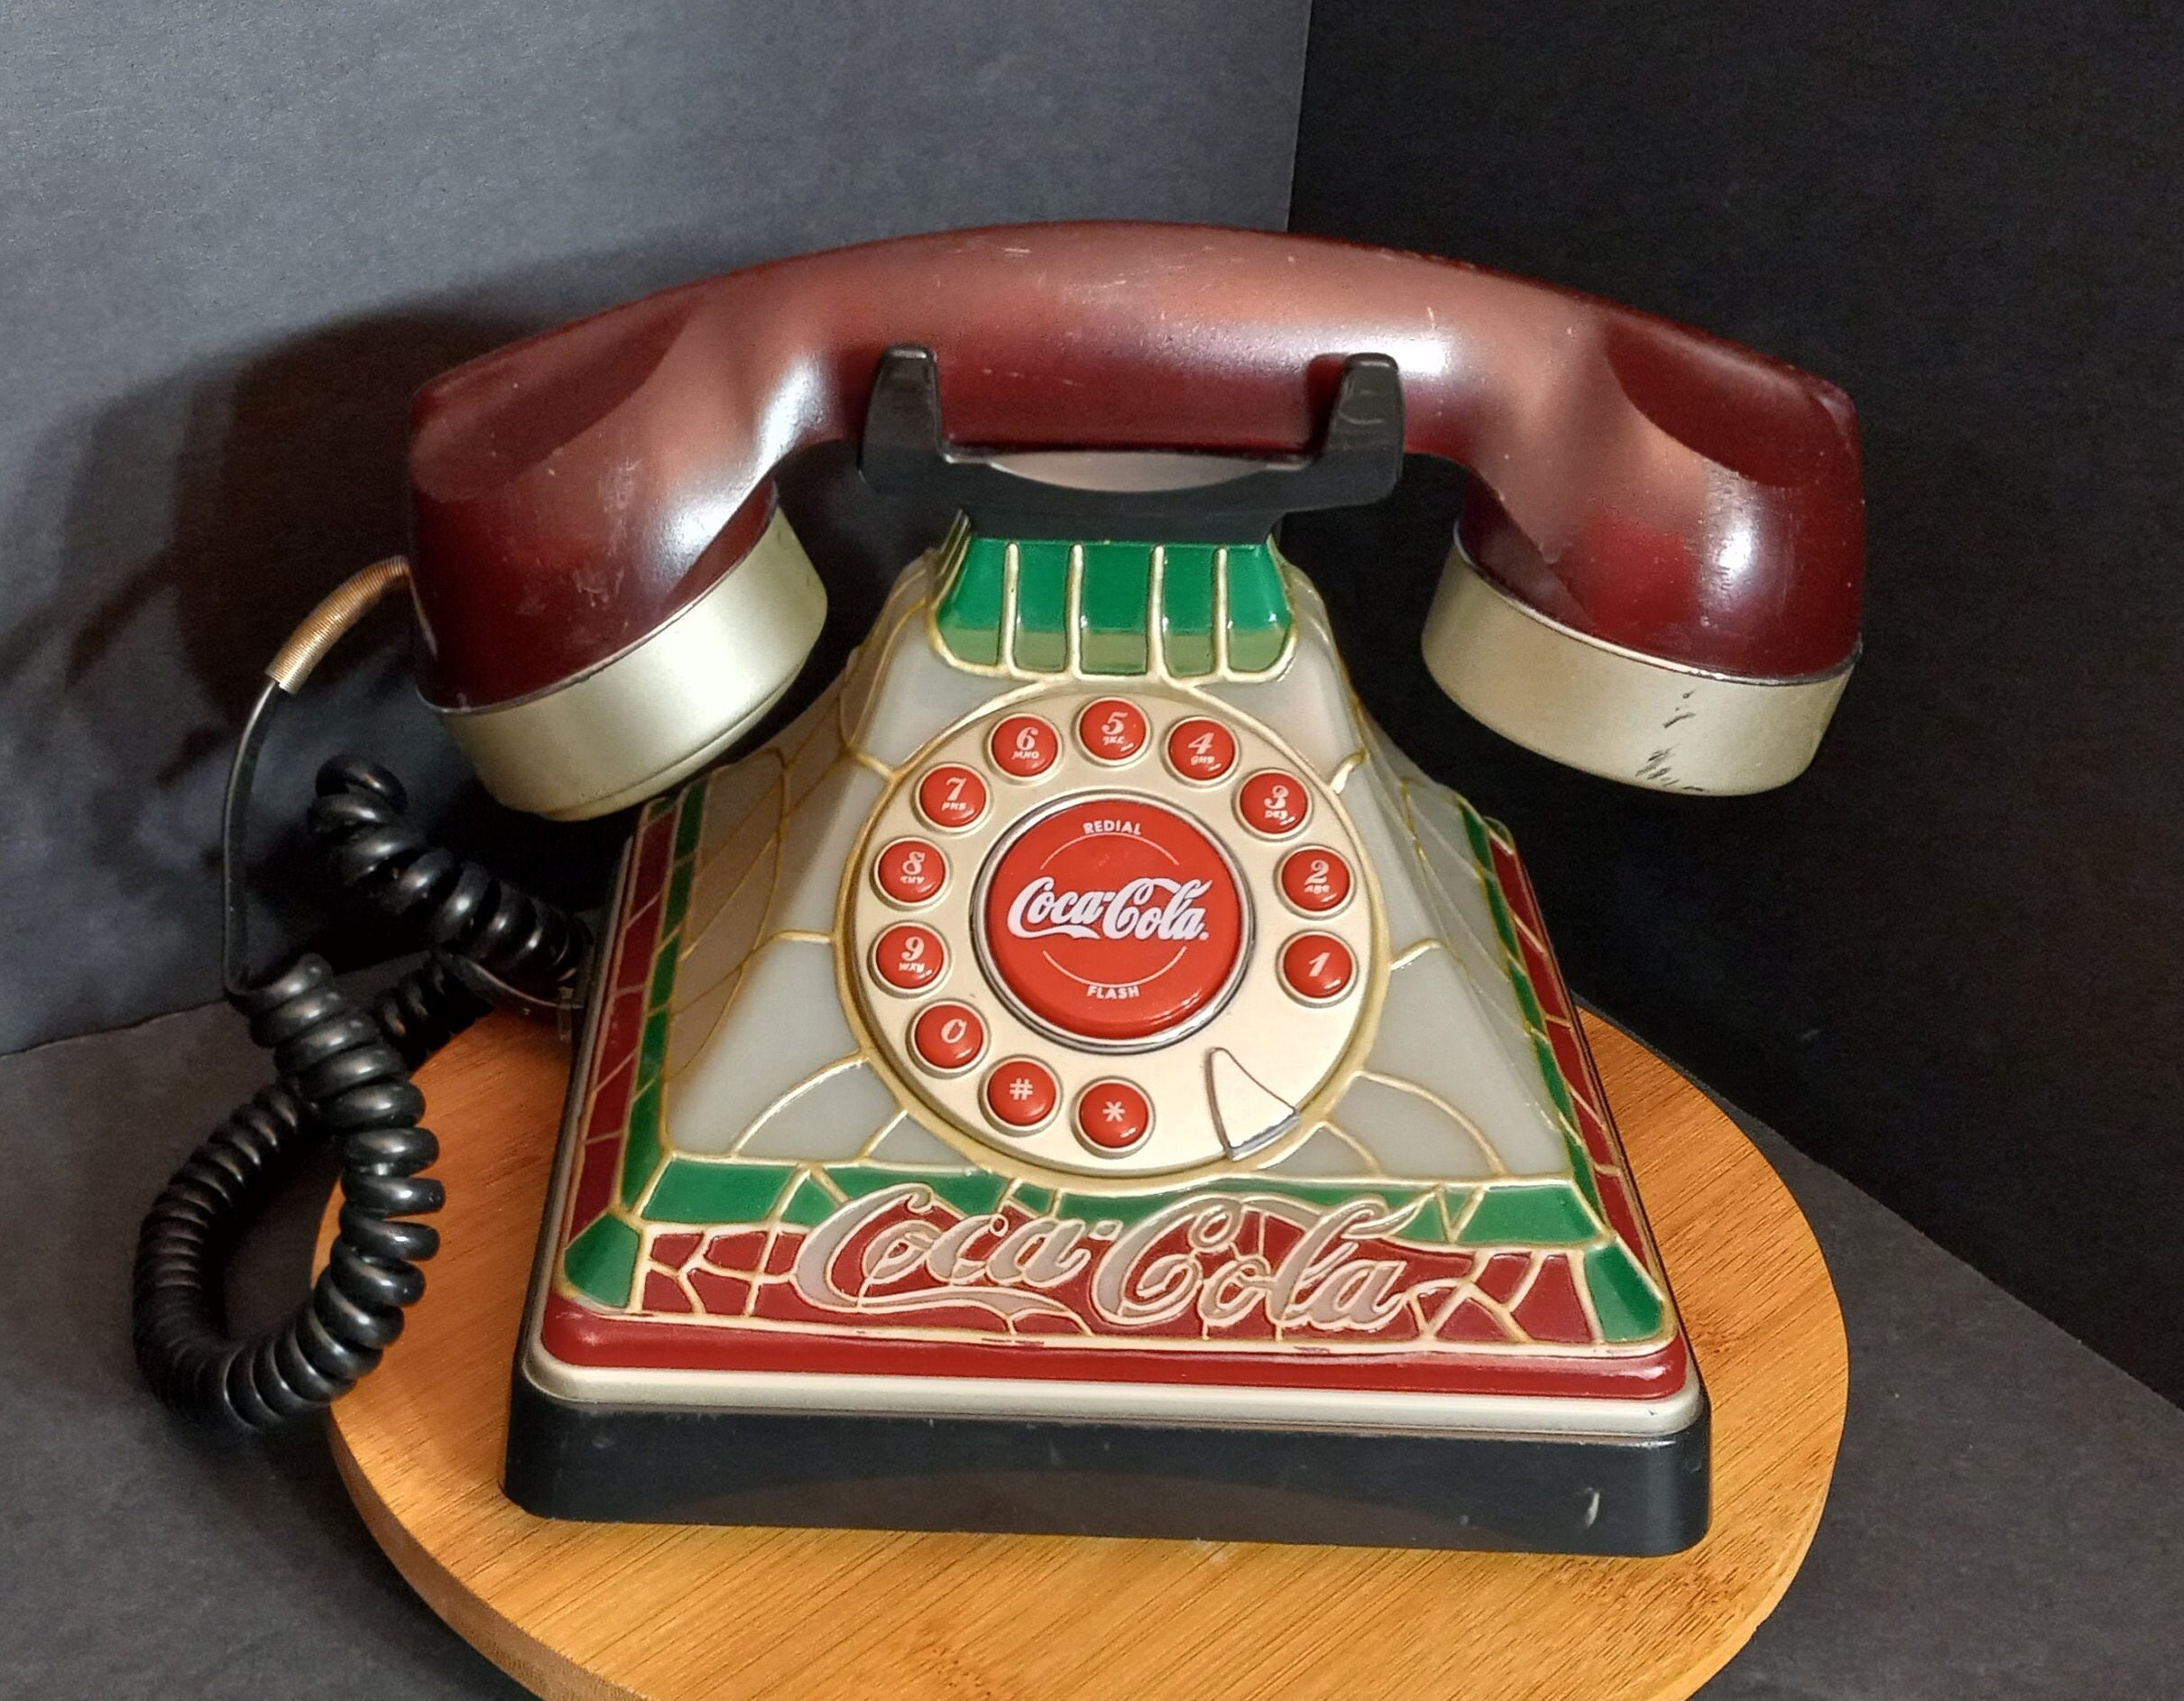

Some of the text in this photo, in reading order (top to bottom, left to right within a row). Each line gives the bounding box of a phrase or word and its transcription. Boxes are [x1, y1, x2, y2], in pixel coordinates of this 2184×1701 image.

[1101, 712, 1128, 735] 5
[1015, 726, 1039, 750] 6
[1187, 732, 1214, 755] 4
[1011, 750, 1040, 760] MNO
[945, 777, 967, 801] 7
[1264, 785, 1289, 809] 3
[1083, 819, 1141, 836] REDIAL
[902, 850, 926, 875] 8
[1304, 860, 1330, 885] 2
[901, 935, 925, 962] 9
[1308, 952, 1331, 977] 1
[1086, 985, 1140, 1000] FLASH
[793, 1182, 1437, 1327] Coca-Cola
